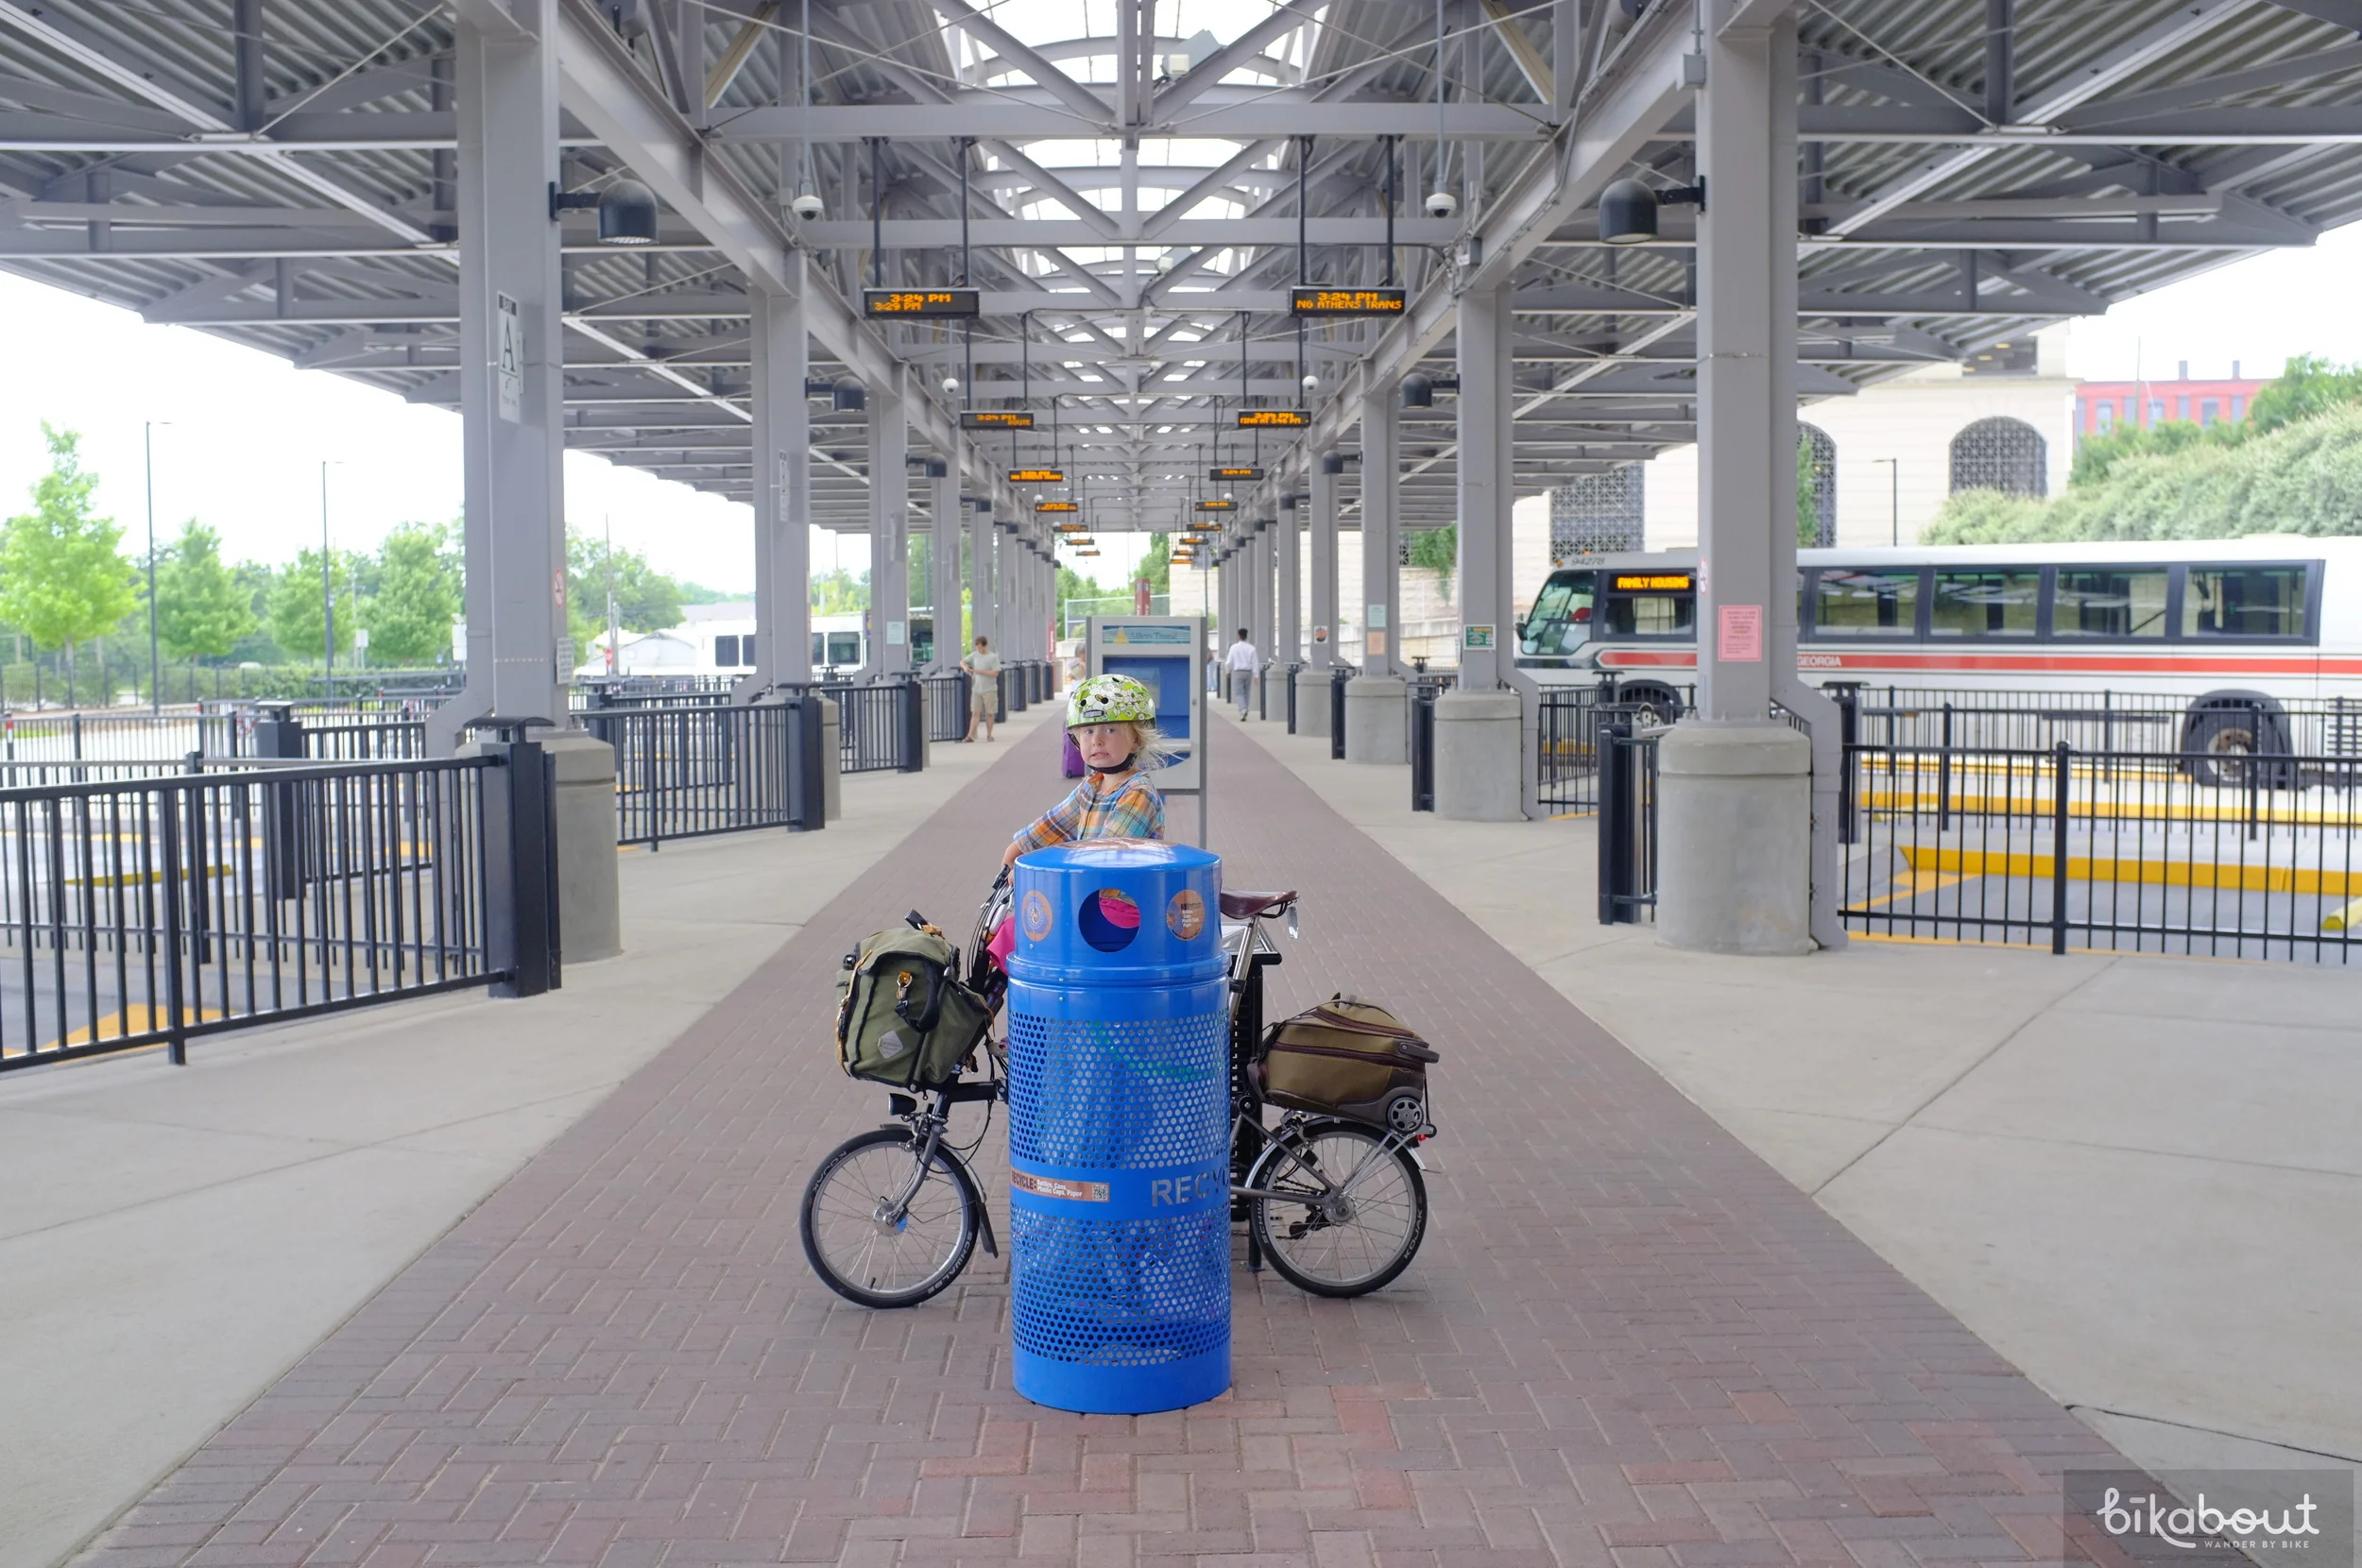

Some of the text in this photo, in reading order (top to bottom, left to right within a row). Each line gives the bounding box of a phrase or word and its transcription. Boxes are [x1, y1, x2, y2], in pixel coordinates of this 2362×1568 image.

[890, 294, 951, 302] 3:24 PM
[1317, 292, 1378, 301] 3:24 PM
[874, 302, 922, 311] 3:29 PM
[1296, 300, 1402, 309] NG ATHENS TRANS
[502, 315, 516, 372] A
[1571, 556, 1605, 566] 94278
[1617, 575, 1689, 588] FAMILY HOUSING
[1797, 656, 1842, 667] GEORGIA
[813, 1150, 847, 1192] KOJAK
[1067, 1189, 1083, 1198] Paper
[1404, 1210, 1422, 1259] KOJAK
[927, 1231, 972, 1294] SCHWALBE
